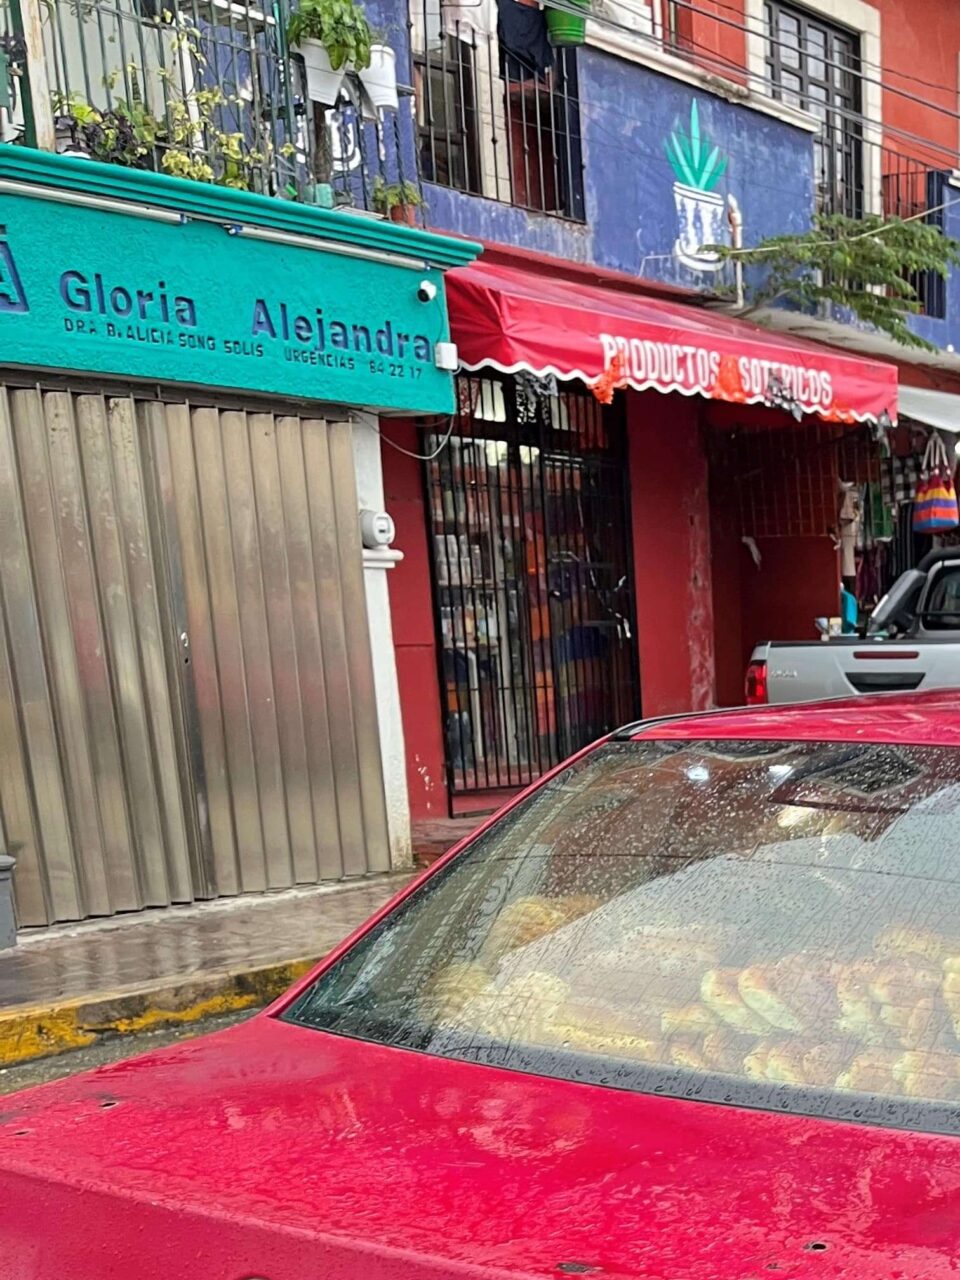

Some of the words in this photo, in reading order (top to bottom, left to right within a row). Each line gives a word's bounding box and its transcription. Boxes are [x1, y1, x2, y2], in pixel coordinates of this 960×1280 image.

[59, 270, 198, 327] Gloria
[252, 299, 432, 362] Alejandra
[126, 325, 175, 345] ALICIA
[178, 332, 216, 351] SONG
[223, 340, 264, 358] SOLIS
[283, 347, 355, 371] URGENCIAS
[598, 333, 720, 389] PRODUCTOS
